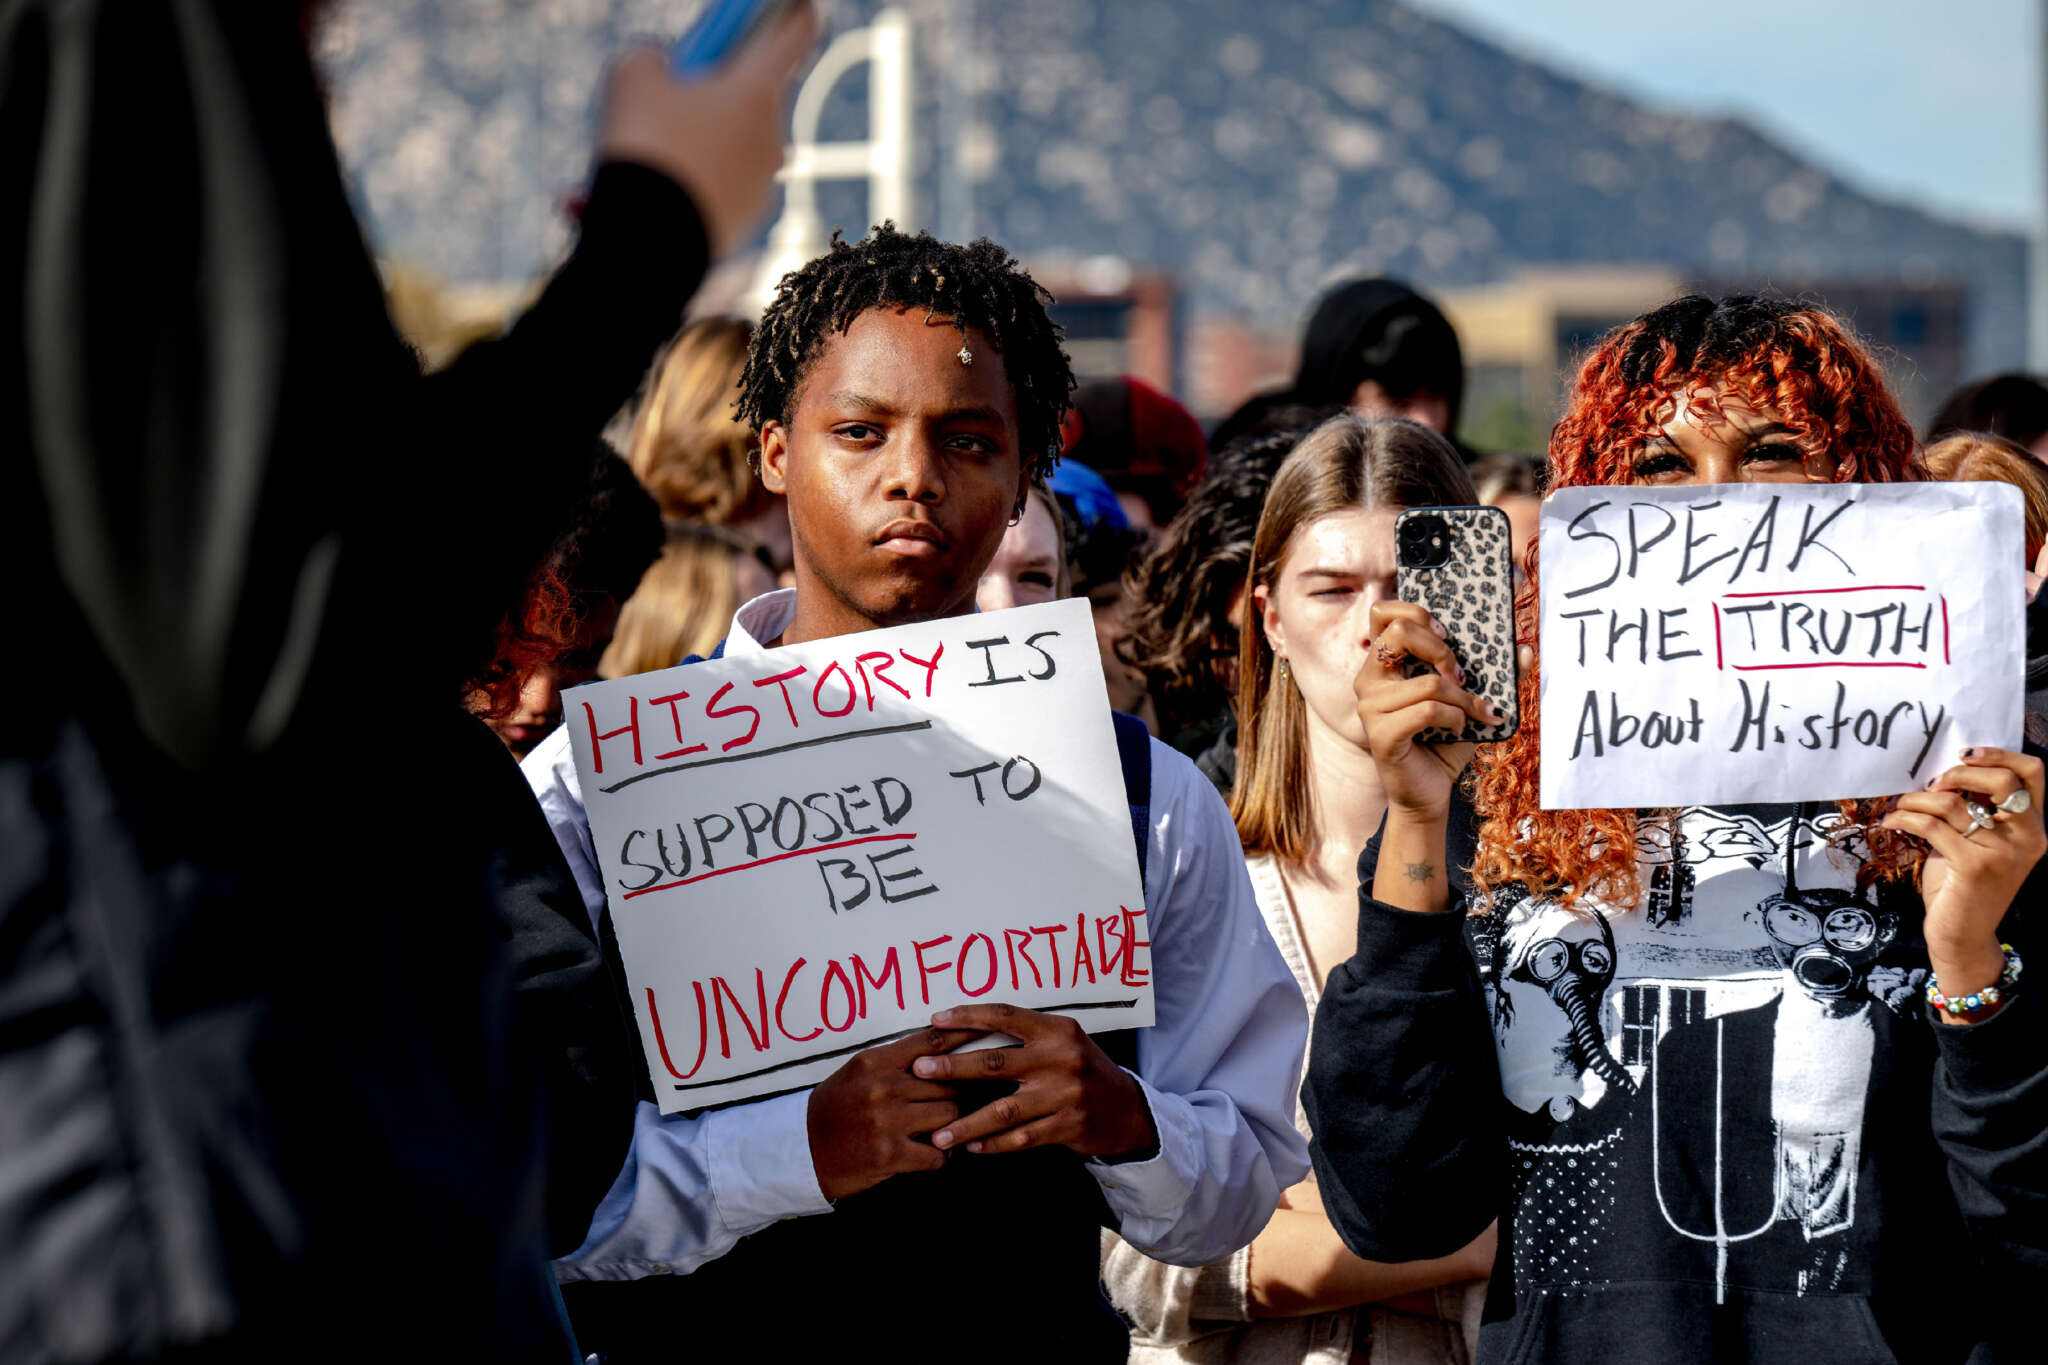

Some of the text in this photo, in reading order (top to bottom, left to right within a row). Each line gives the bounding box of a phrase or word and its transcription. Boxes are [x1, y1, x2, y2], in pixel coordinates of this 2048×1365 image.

[1564, 495, 1856, 599] SPEAK
[1560, 601, 1933, 667] THE TRUTH
[584, 631, 1061, 774] HISTORY IS
[1569, 678, 1944, 780] About History
[619, 755, 1042, 892] SUPPOSED TO
[817, 845, 940, 914] BE
